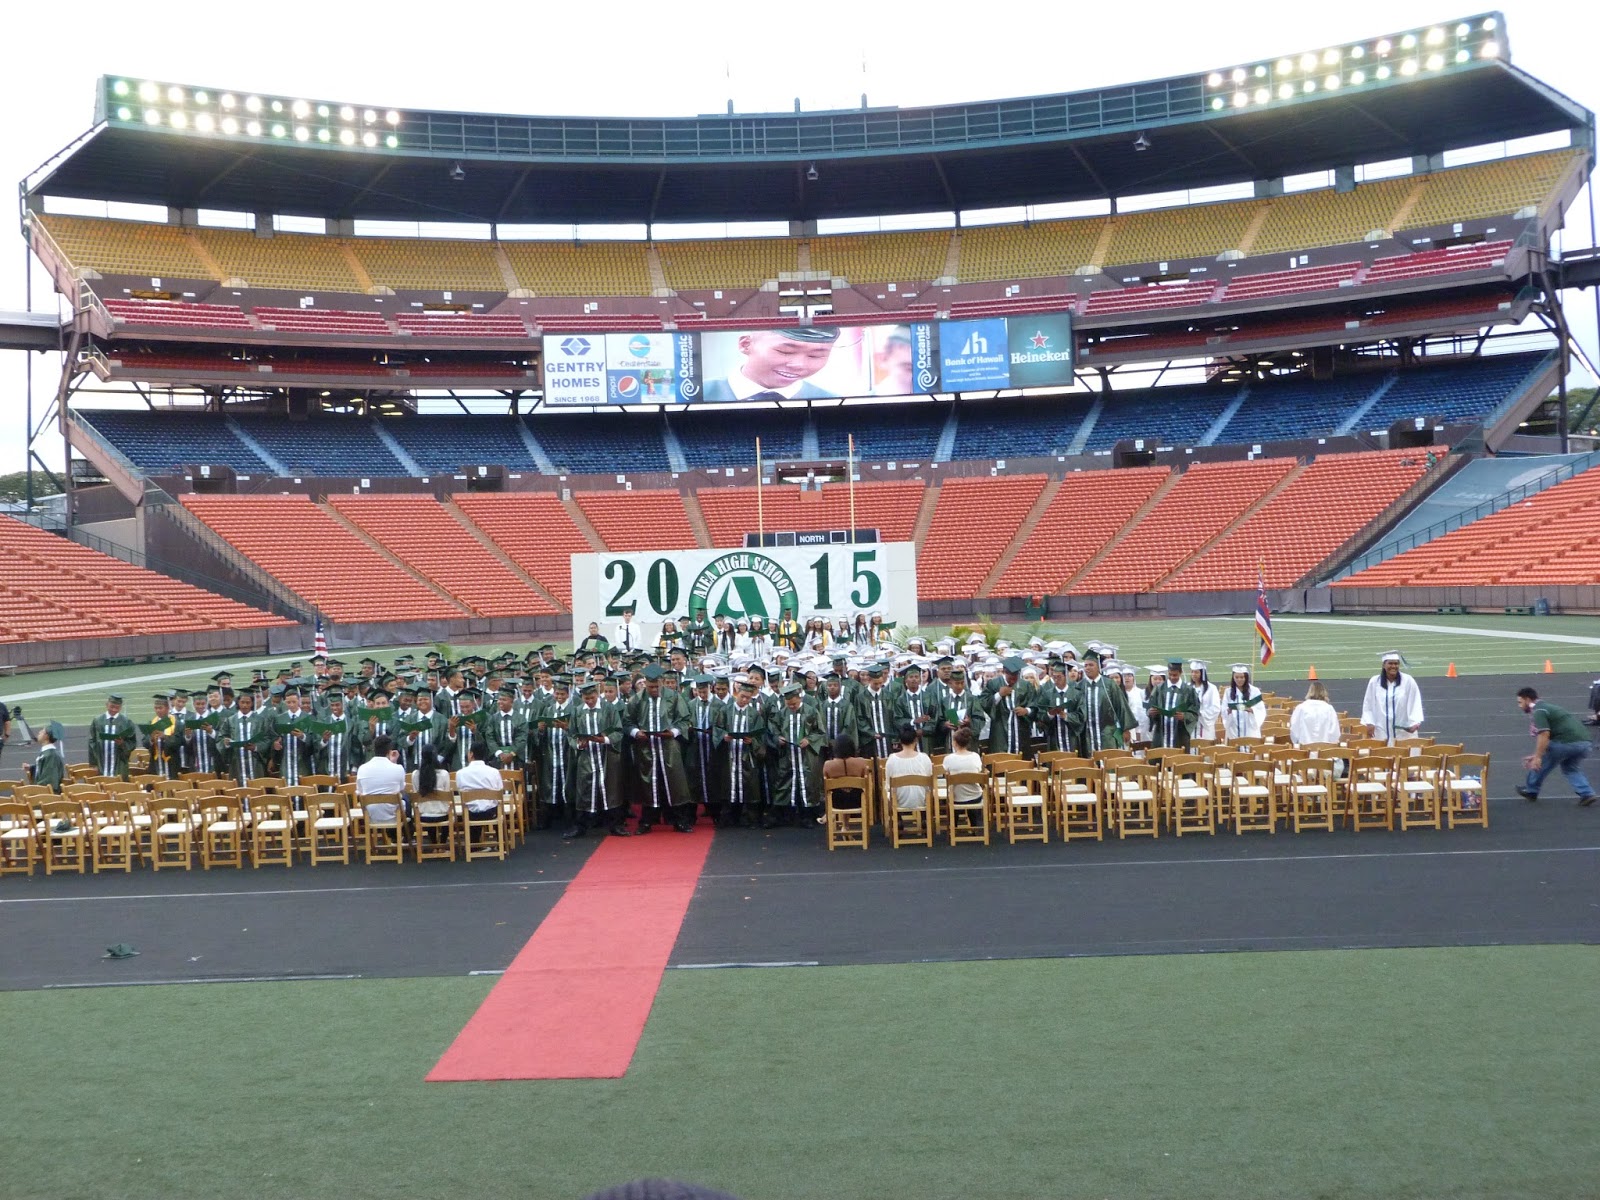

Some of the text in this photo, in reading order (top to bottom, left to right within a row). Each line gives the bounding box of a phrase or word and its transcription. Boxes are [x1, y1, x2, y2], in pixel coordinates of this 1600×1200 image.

[916, 325, 927, 369] Oceanic
[679, 335, 689, 378] Oceanic
[945, 354, 1004, 367] Bank of Hawaii
[1011, 350, 1070, 364] Heineken
[546, 362, 605, 372] GENTRY
[552, 377, 601, 388] HOMES
[608, 375, 618, 399] pepsi
[799, 535, 825, 543] NORTH
[693, 554, 793, 600] AIEA HIGH SCHOOL
